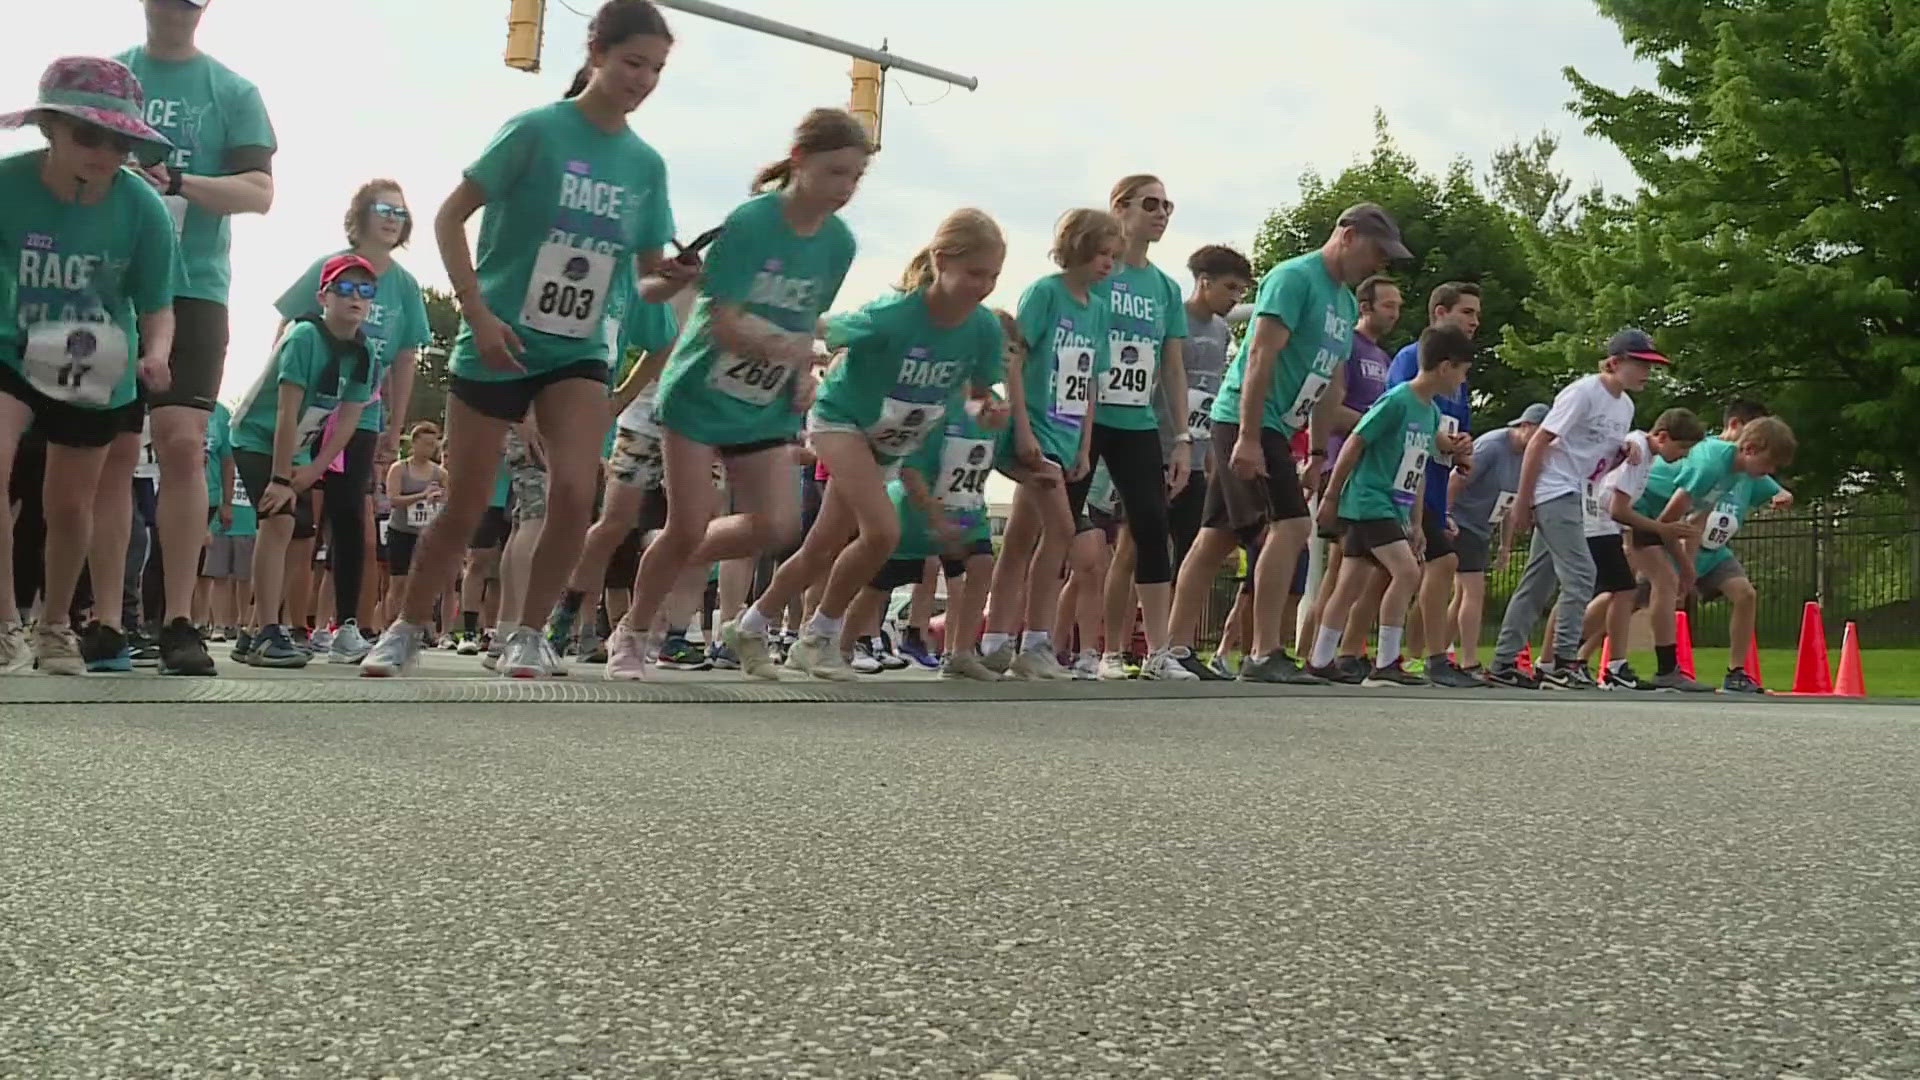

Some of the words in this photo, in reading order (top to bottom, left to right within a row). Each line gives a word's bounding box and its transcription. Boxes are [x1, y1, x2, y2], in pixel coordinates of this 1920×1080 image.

[558, 172, 624, 219] RACE
[19, 250, 97, 290] RACE
[538, 281, 595, 320] 803
[1110, 290, 1155, 321] RACE
[1066, 375, 1092, 401] 25
[1109, 367, 1148, 393] 249
